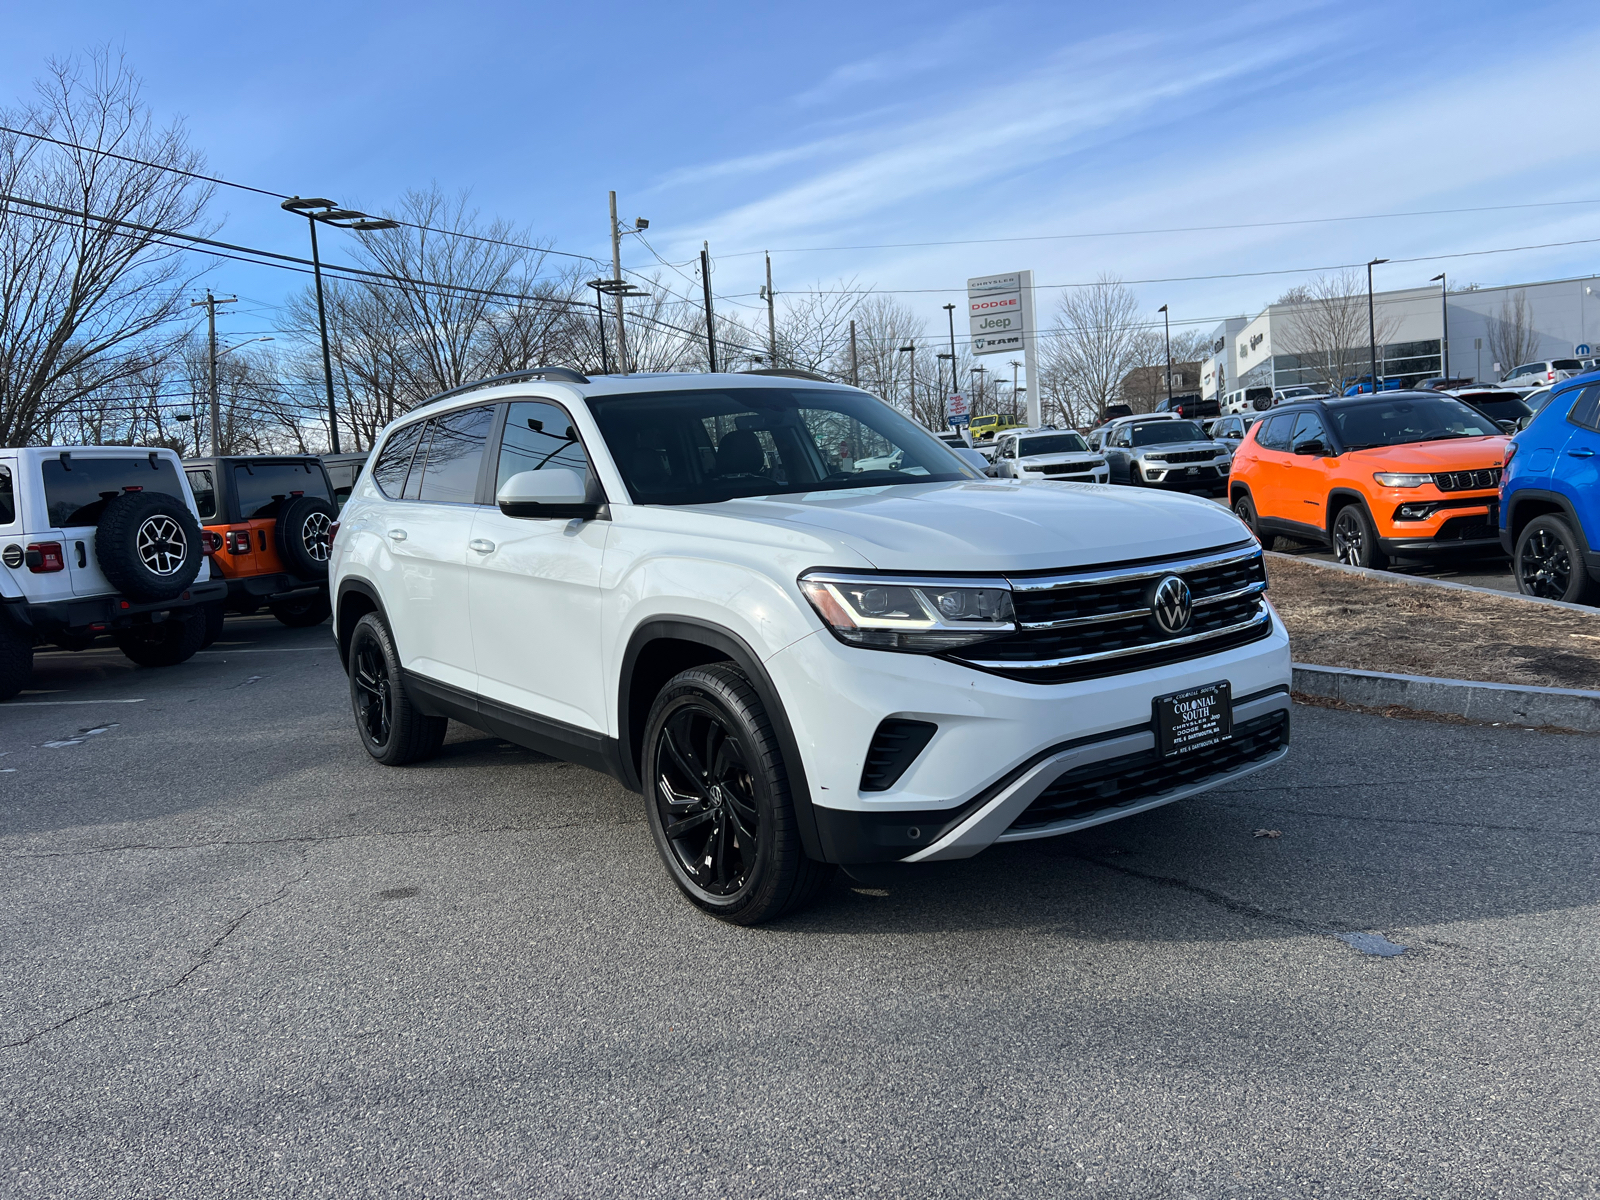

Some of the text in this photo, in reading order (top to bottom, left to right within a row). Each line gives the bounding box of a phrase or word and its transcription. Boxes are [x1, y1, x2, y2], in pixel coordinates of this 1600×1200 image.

[972, 278, 1014, 287] CHRYSLER
[972, 299, 1017, 310] DODGE
[980, 318, 1011, 329] Jeep
[987, 337, 1019, 346] RAM
[1174, 696, 1216, 714] COLONIAL
[1182, 707, 1210, 722] SOUTH
[1172, 713, 1221, 730] CHRYSLER Jeep
[1177, 726, 1199, 736] DODGE
